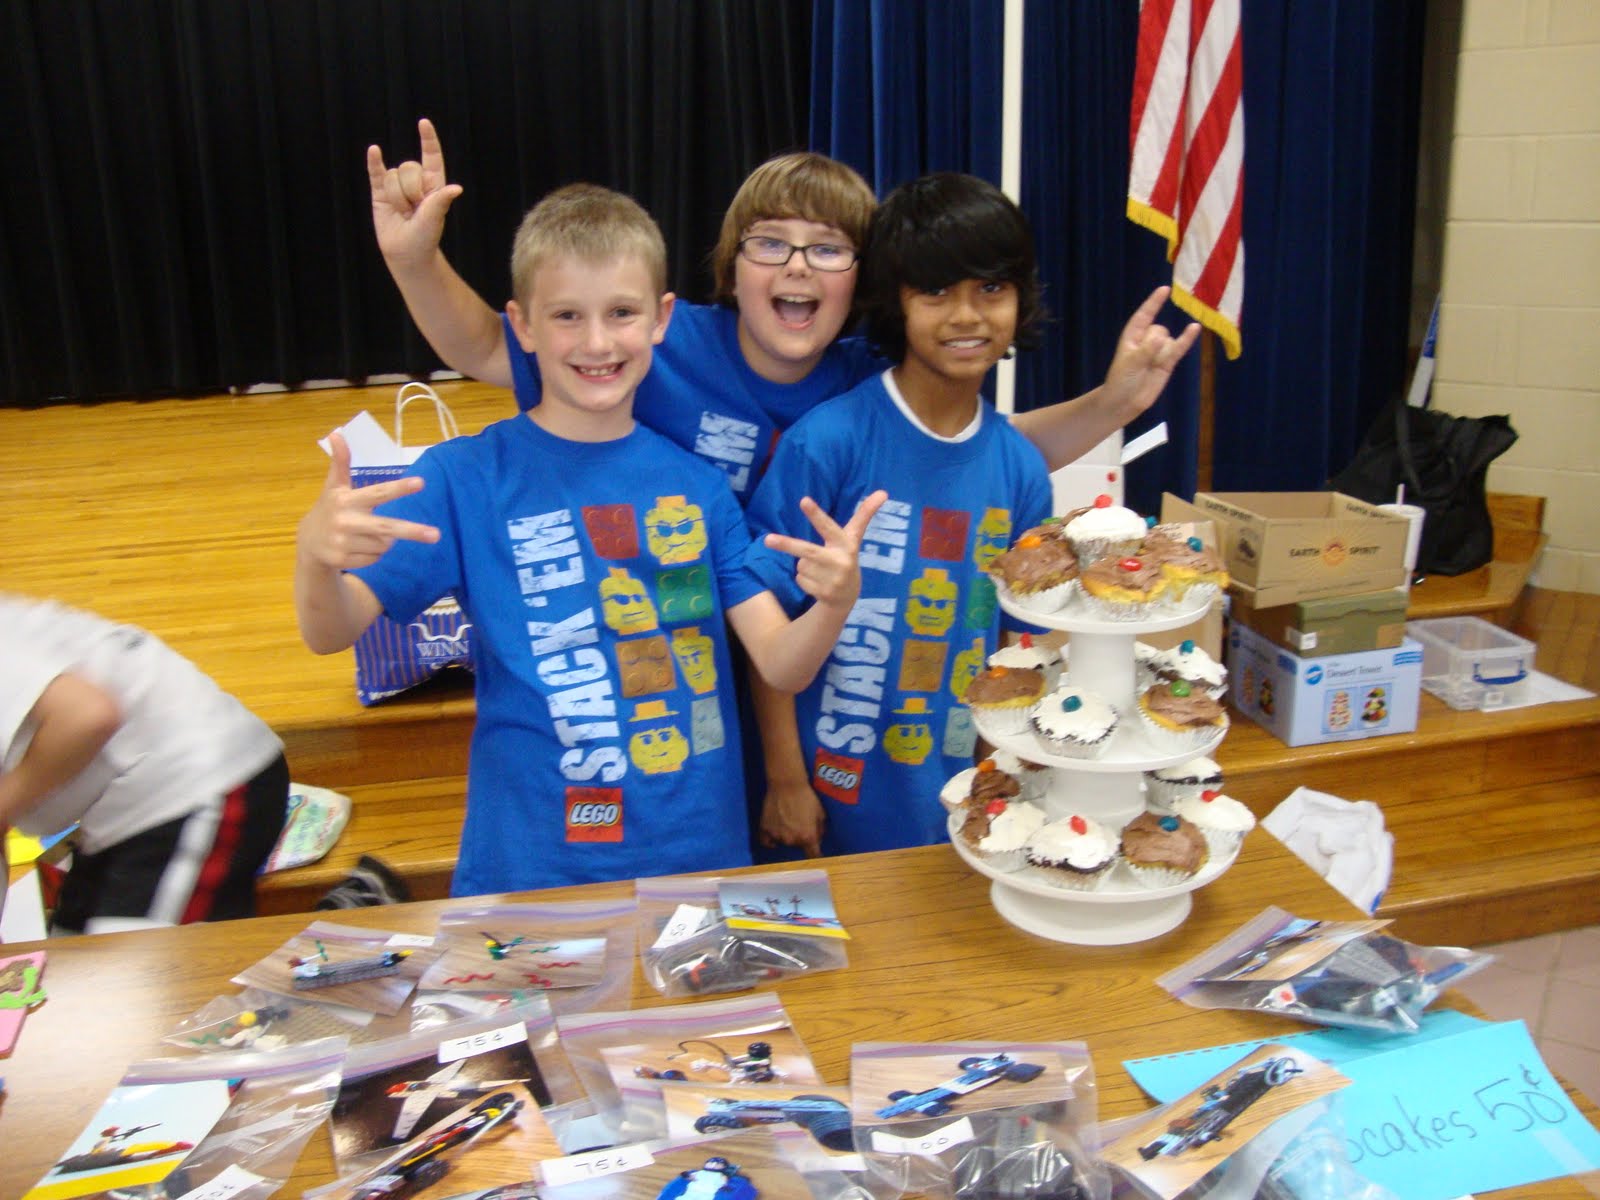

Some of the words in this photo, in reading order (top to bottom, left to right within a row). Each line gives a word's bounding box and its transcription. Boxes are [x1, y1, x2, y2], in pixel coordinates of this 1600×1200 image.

[1289, 548, 1321, 556] EARTH
[1349, 546, 1381, 555] SPIRIT
[527, 607, 629, 783] STACK
[816, 764, 858, 790] LEGO
[570, 803, 619, 825] LEGO
